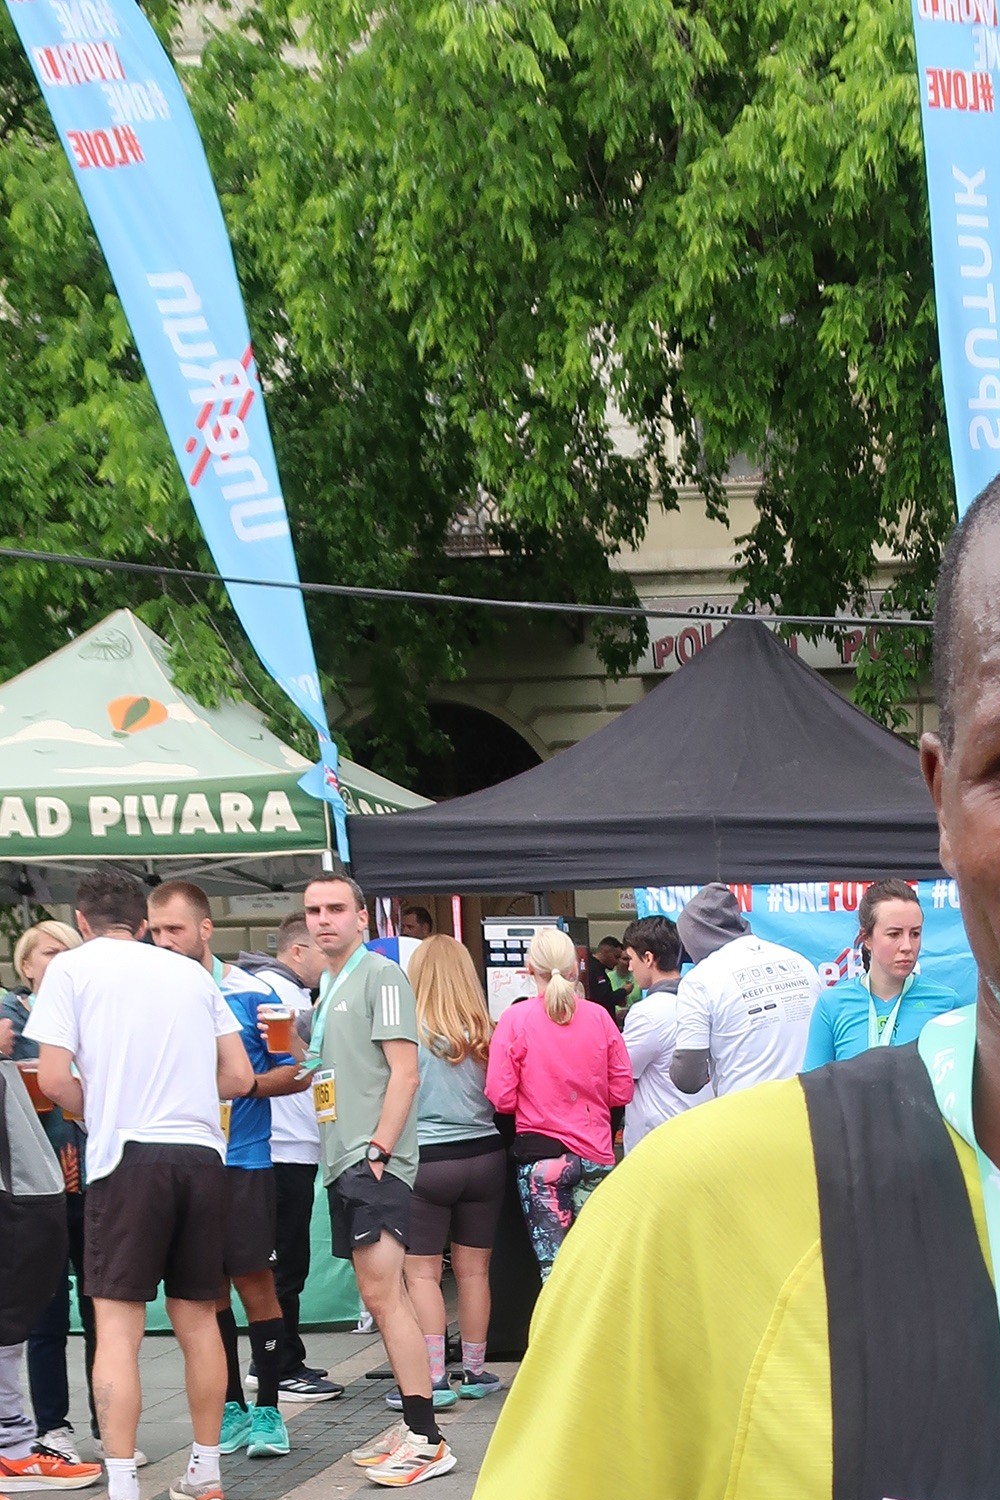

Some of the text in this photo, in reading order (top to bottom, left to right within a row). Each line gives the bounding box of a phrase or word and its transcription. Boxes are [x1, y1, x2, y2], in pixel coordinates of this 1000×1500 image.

[88, 790, 302, 837] PIVARA
[742, 987, 764, 1000] KEEP
[774, 978, 809, 991] RUNNING
